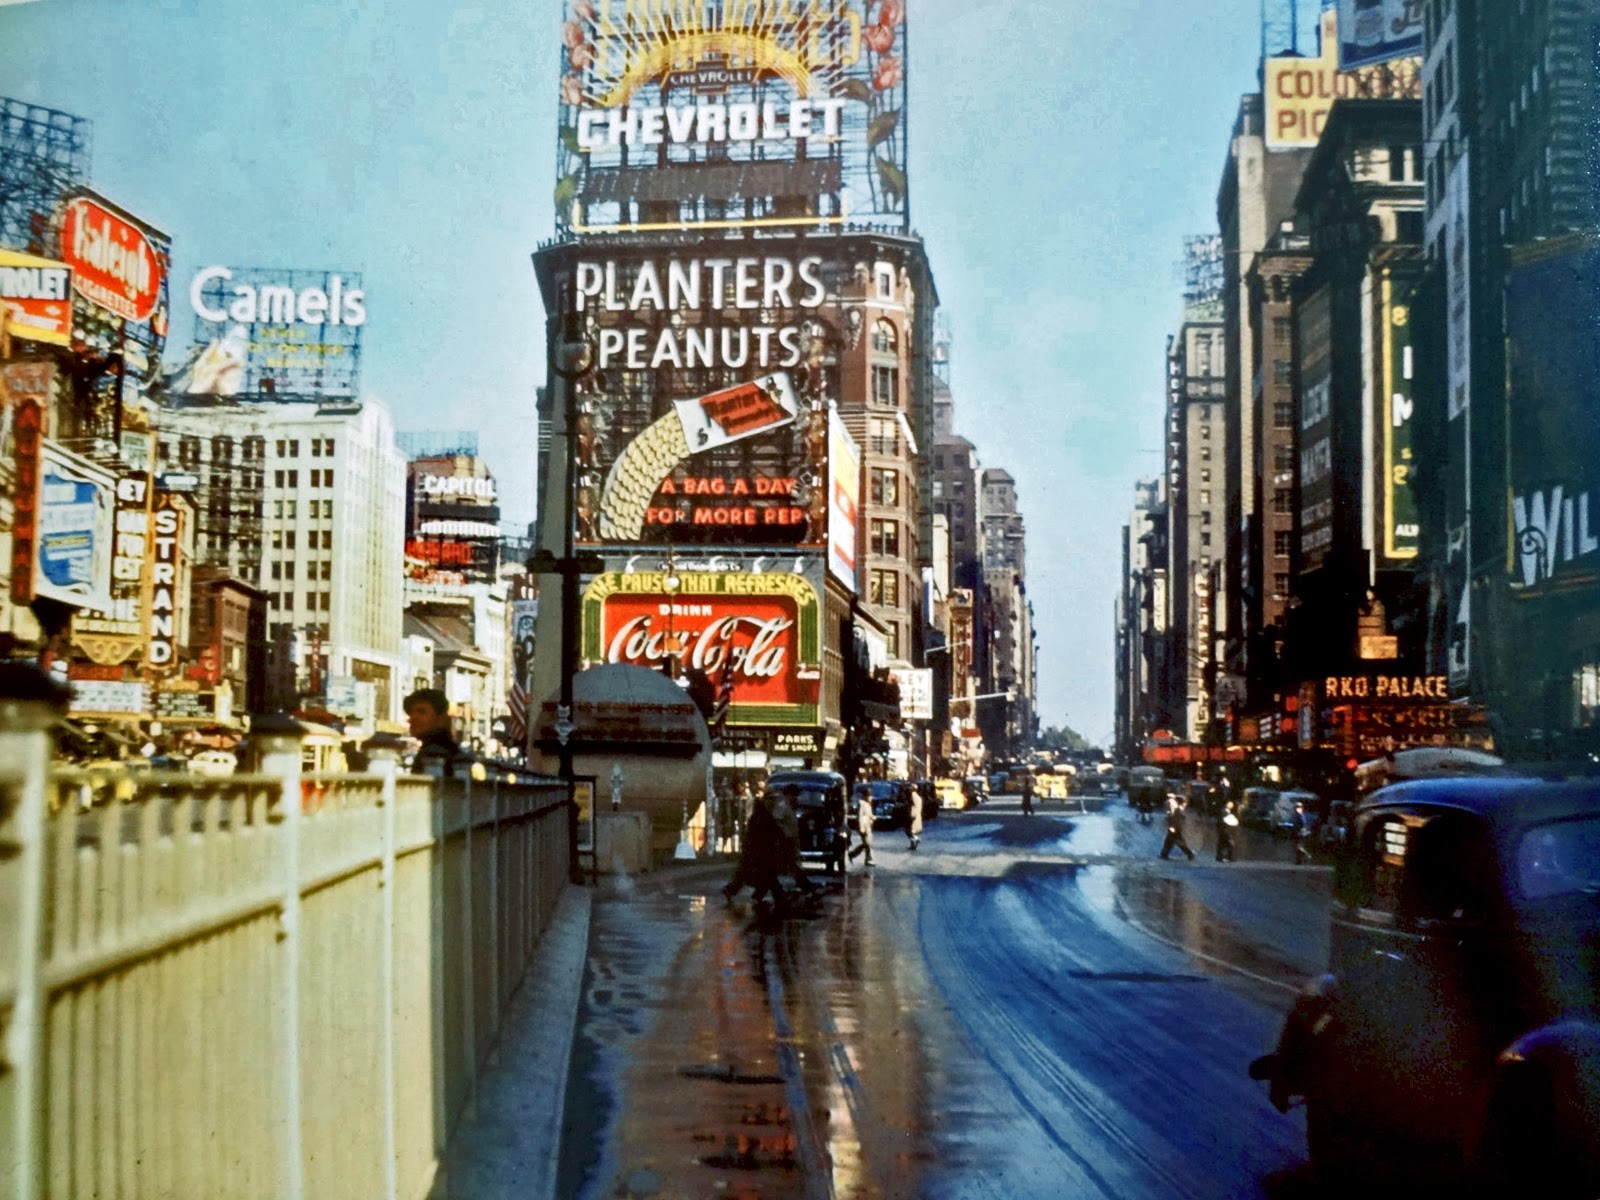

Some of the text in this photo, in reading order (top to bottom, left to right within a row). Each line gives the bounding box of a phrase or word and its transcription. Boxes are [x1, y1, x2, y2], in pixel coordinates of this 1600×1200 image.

[670, 71, 752, 84] CHEVROLET
[577, 99, 847, 148] CHEVROLET
[576, 256, 827, 312] PLANTERS
[189, 265, 368, 327] Camels
[599, 325, 801, 369] PEANUTS
[424, 475, 496, 496] CAPITOL
[660, 477, 798, 494] A BAG A DAY
[646, 507, 804, 525] FOR MORE PEP
[149, 510, 178, 664] STRAND
[587, 572, 618, 601] THE
[680, 573, 720, 592] THAT
[725, 573, 815, 607] REFRESHES
[658, 604, 713, 616] DRINK
[1325, 676, 1448, 698] RKO PALACE
[777, 734, 814, 744] PARKS
